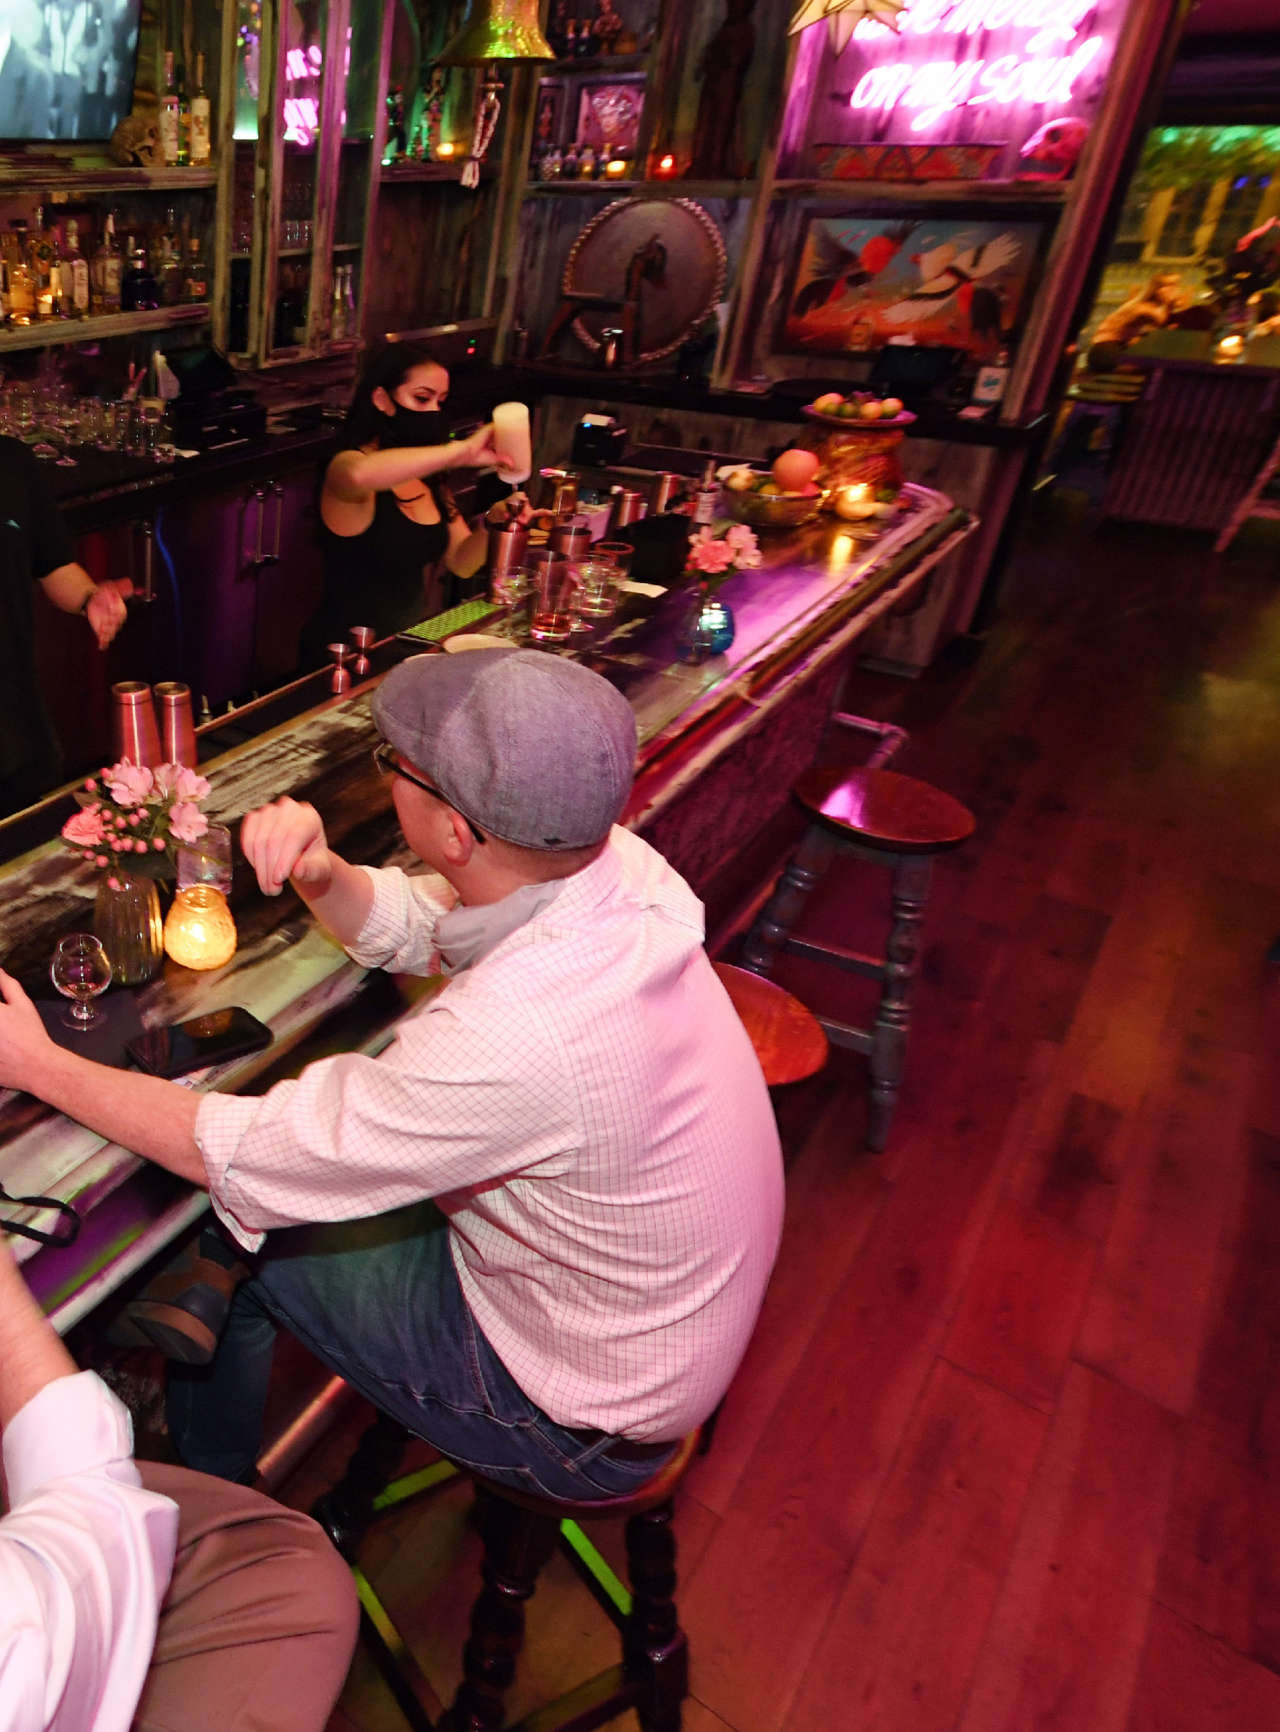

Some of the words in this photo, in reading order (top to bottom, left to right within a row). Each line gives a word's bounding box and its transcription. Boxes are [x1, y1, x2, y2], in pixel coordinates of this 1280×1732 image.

[852, 64, 910, 110] on
[901, 61, 984, 131] my
[969, 37, 1102, 104] soul
